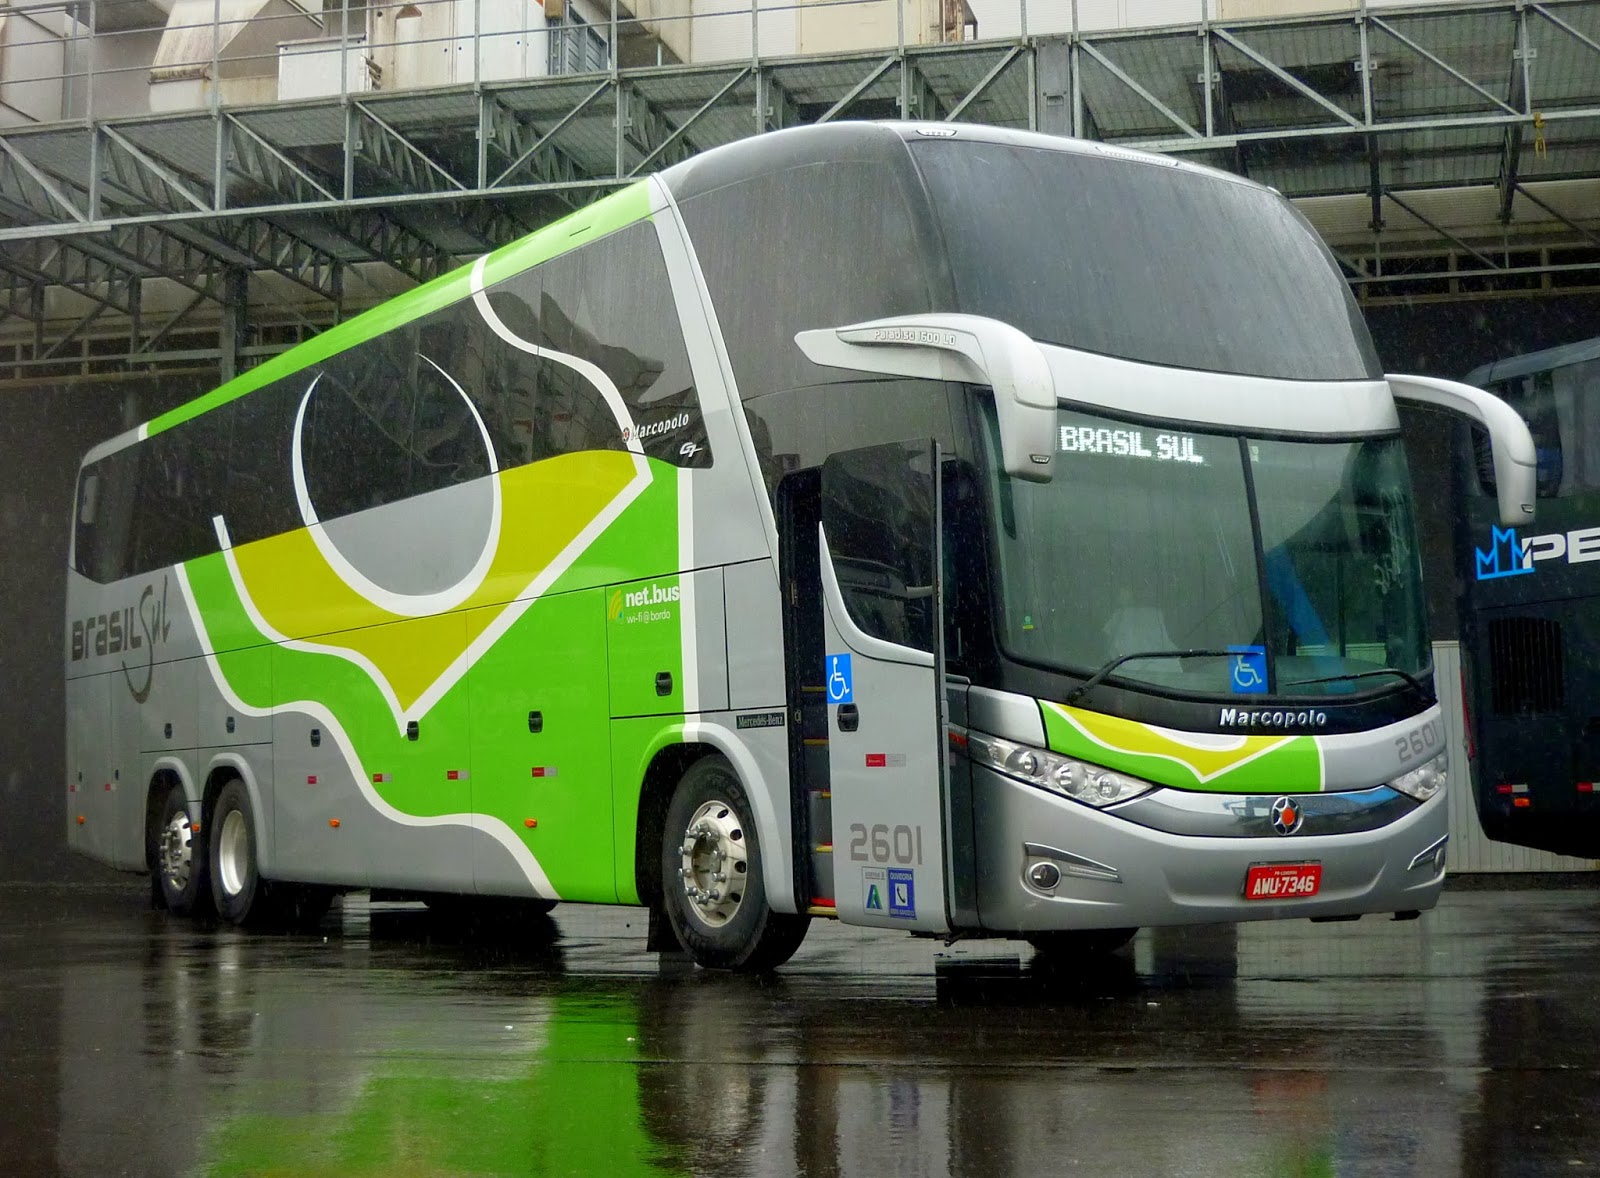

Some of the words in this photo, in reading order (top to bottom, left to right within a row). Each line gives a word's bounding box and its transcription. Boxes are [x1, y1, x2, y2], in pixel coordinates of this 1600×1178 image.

[630, 413, 690, 441] Marcopolo
[1060, 425, 1152, 457] BRASIL
[1156, 434, 1204, 463] SUL
[625, 583, 680, 608] net.bus
[1219, 708, 1327, 728] Marcopolo
[849, 823, 923, 865] 2601
